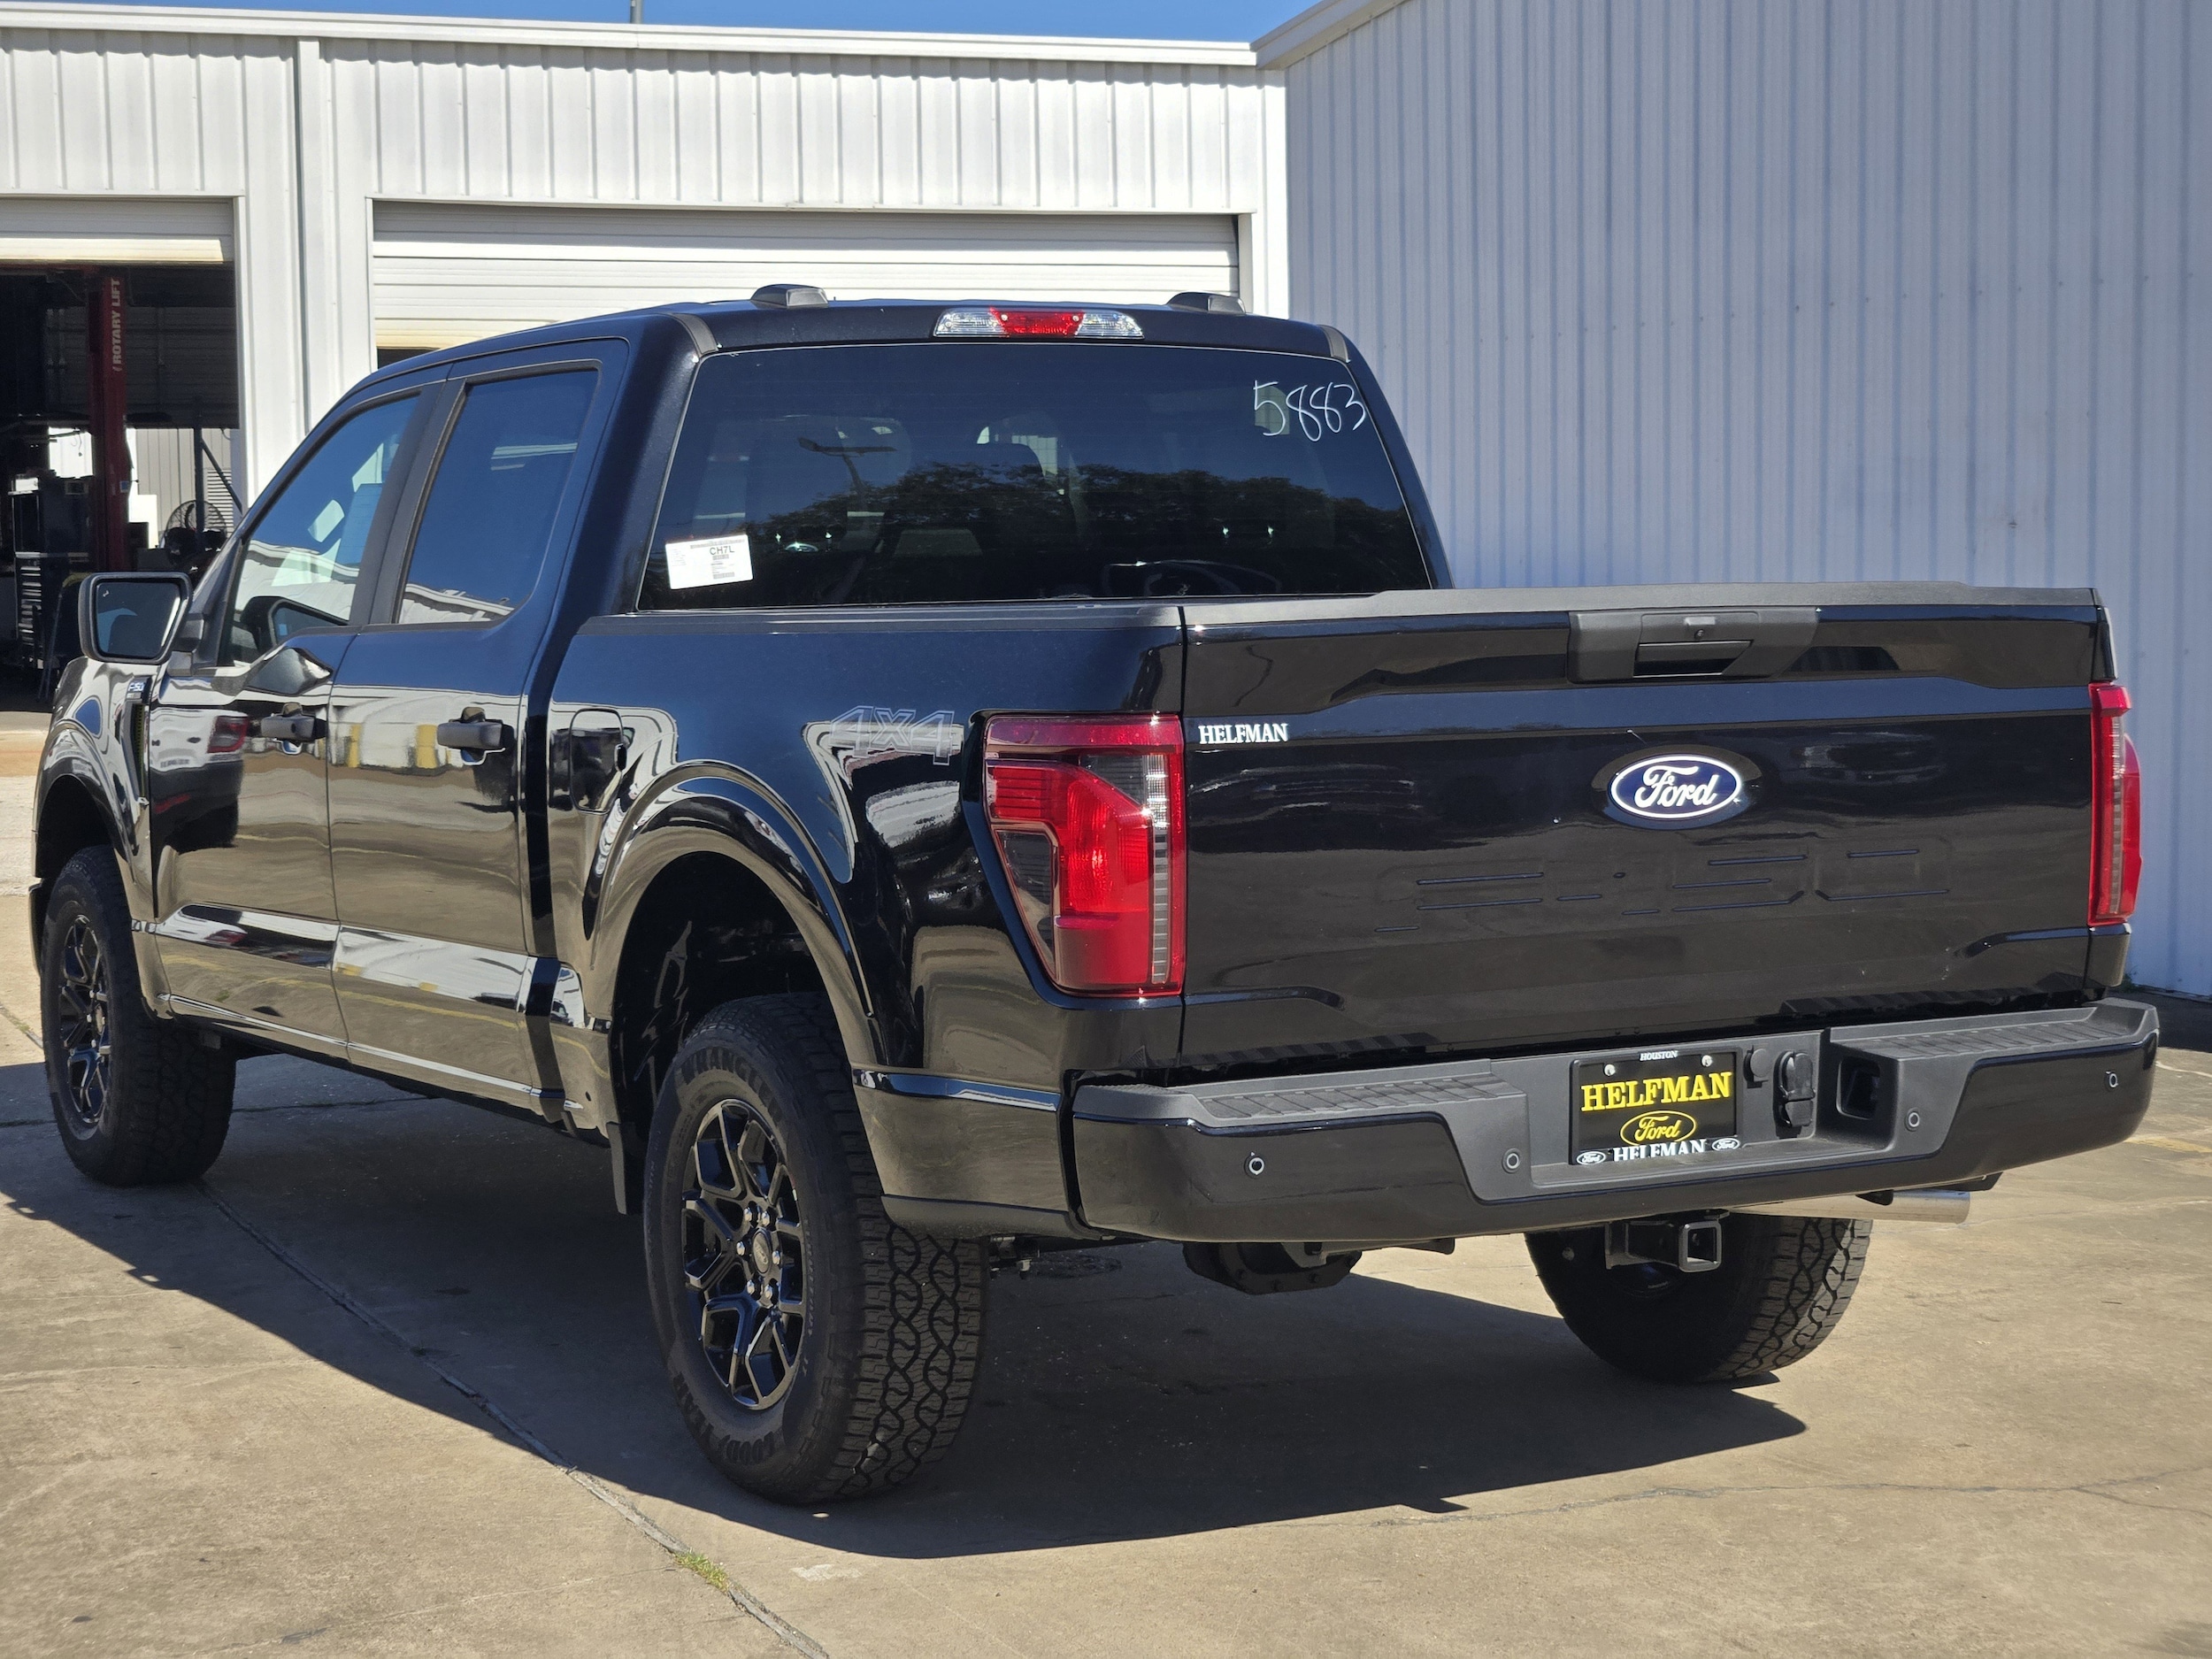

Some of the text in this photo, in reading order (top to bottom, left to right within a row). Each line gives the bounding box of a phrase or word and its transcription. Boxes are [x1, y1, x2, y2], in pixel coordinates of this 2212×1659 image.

[111, 277, 122, 365] ROTARY LIFT
[1253, 380, 1366, 442] 5883
[709, 545, 735, 556] CH7L
[1197, 723, 1289, 745] HELFMAN
[1633, 764, 1720, 809] Ford
[1640, 1050, 1678, 1062] HOUSTON
[1580, 1071, 1733, 1112] HELFMAN
[1634, 1115, 1682, 1142] Ford
[1613, 1139, 1707, 1163] HELFMAN
